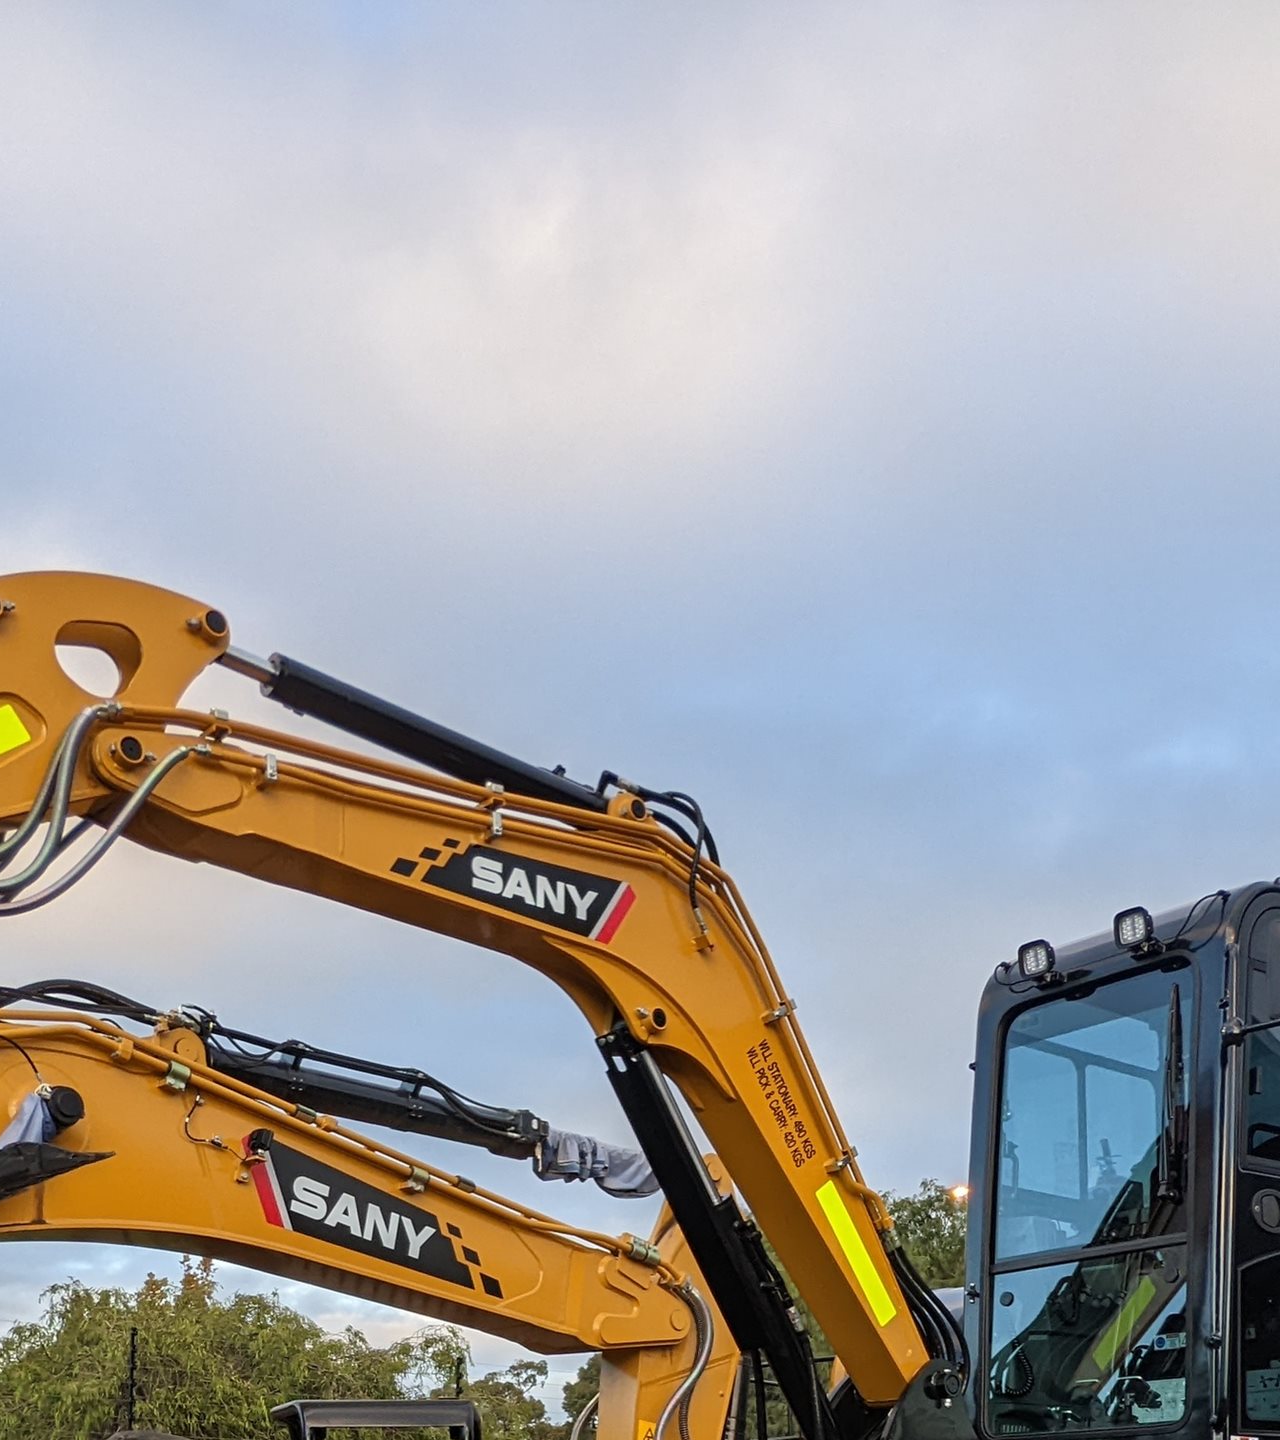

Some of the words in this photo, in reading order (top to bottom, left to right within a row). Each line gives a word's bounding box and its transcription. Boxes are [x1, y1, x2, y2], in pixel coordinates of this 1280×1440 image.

[471, 855, 598, 921] SANY
[746, 1046, 761, 1069] WLL
[755, 1067, 771, 1091] PICK
[765, 1090, 775, 1100] &
[784, 1131, 797, 1148] 420
[791, 1148, 805, 1168] KGS
[758, 1039, 773, 1062] WLL
[767, 1062, 799, 1120] STATIONARY:
[802, 1137, 816, 1159] KGS
[290, 1175, 436, 1260] SANY
